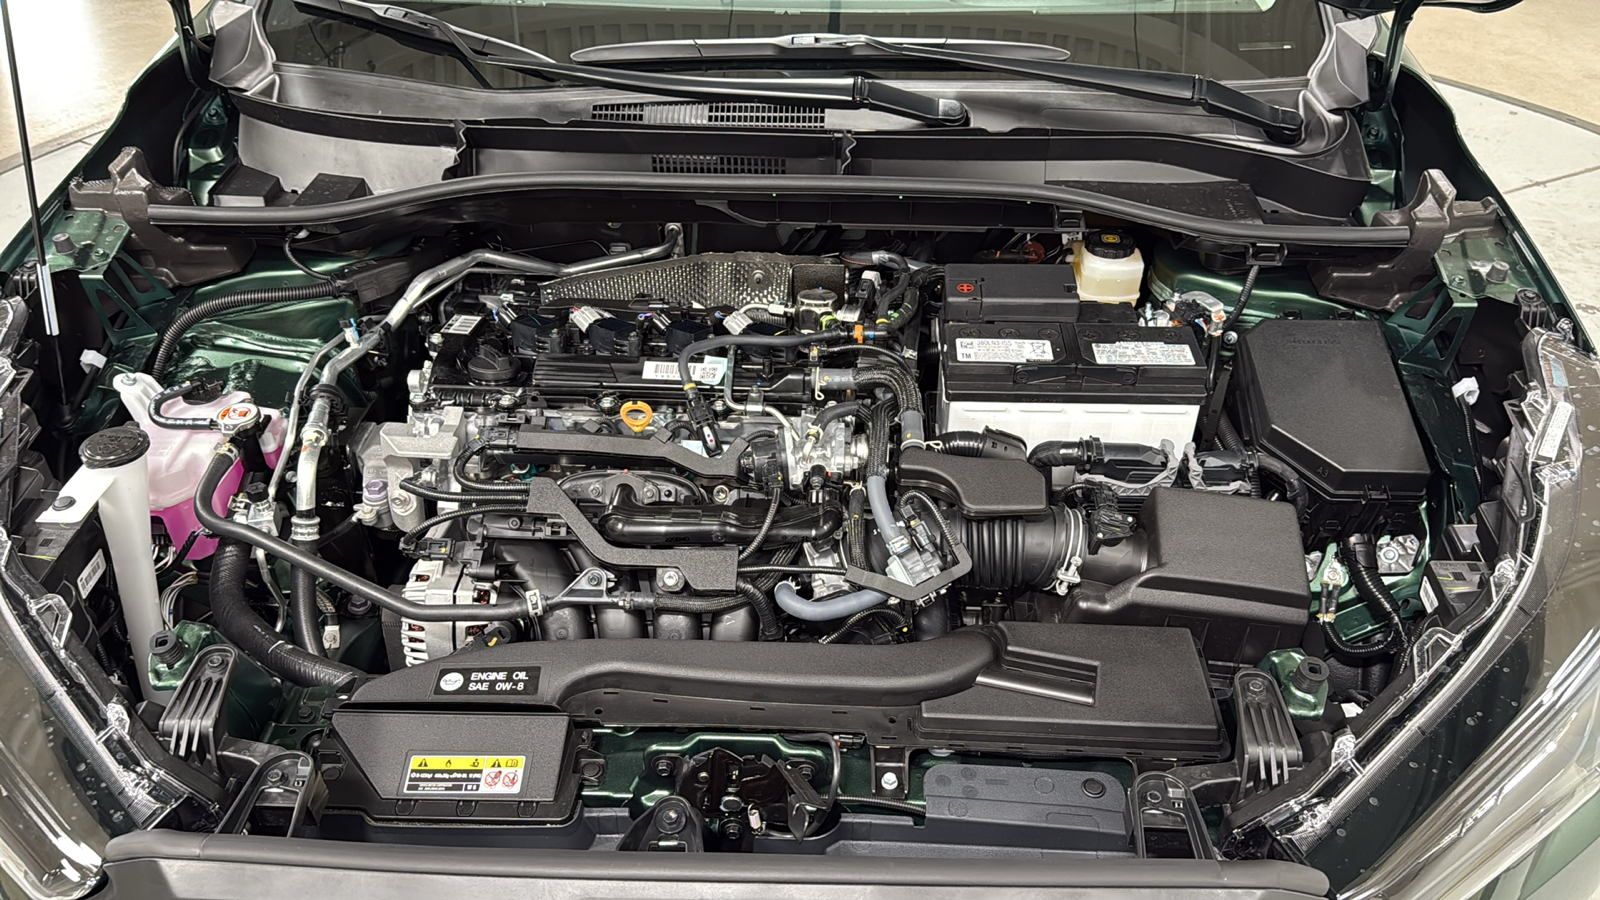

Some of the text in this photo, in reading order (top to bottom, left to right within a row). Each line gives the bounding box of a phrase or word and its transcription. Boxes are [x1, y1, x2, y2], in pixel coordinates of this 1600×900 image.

[1316, 466, 1329, 478] A3
[471, 671, 529, 680] ENGINE OIL
[468, 682, 524, 691] SAE 0W-8
